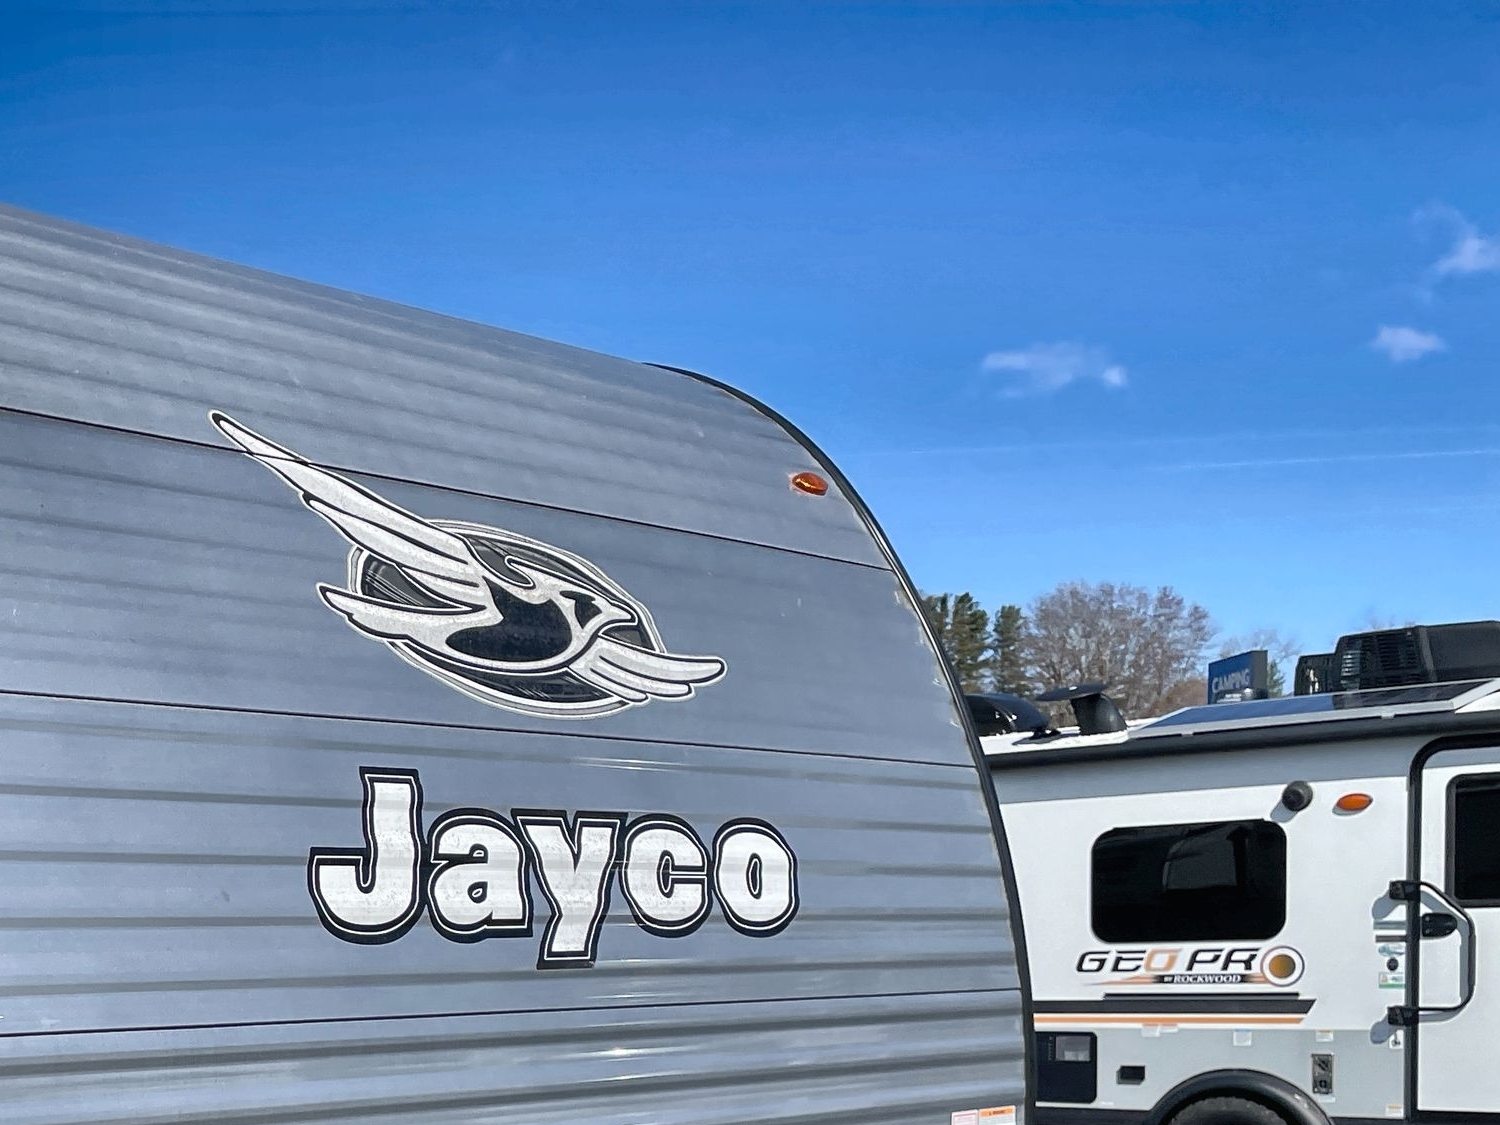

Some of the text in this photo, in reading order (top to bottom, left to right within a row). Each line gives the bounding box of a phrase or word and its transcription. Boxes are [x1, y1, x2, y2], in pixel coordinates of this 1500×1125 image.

[1212, 668, 1250, 693] CAMPING
[309, 766, 797, 969] Jayco
[1076, 948, 1182, 973] GEO
[1173, 973, 1241, 984] ROCKWOOD
